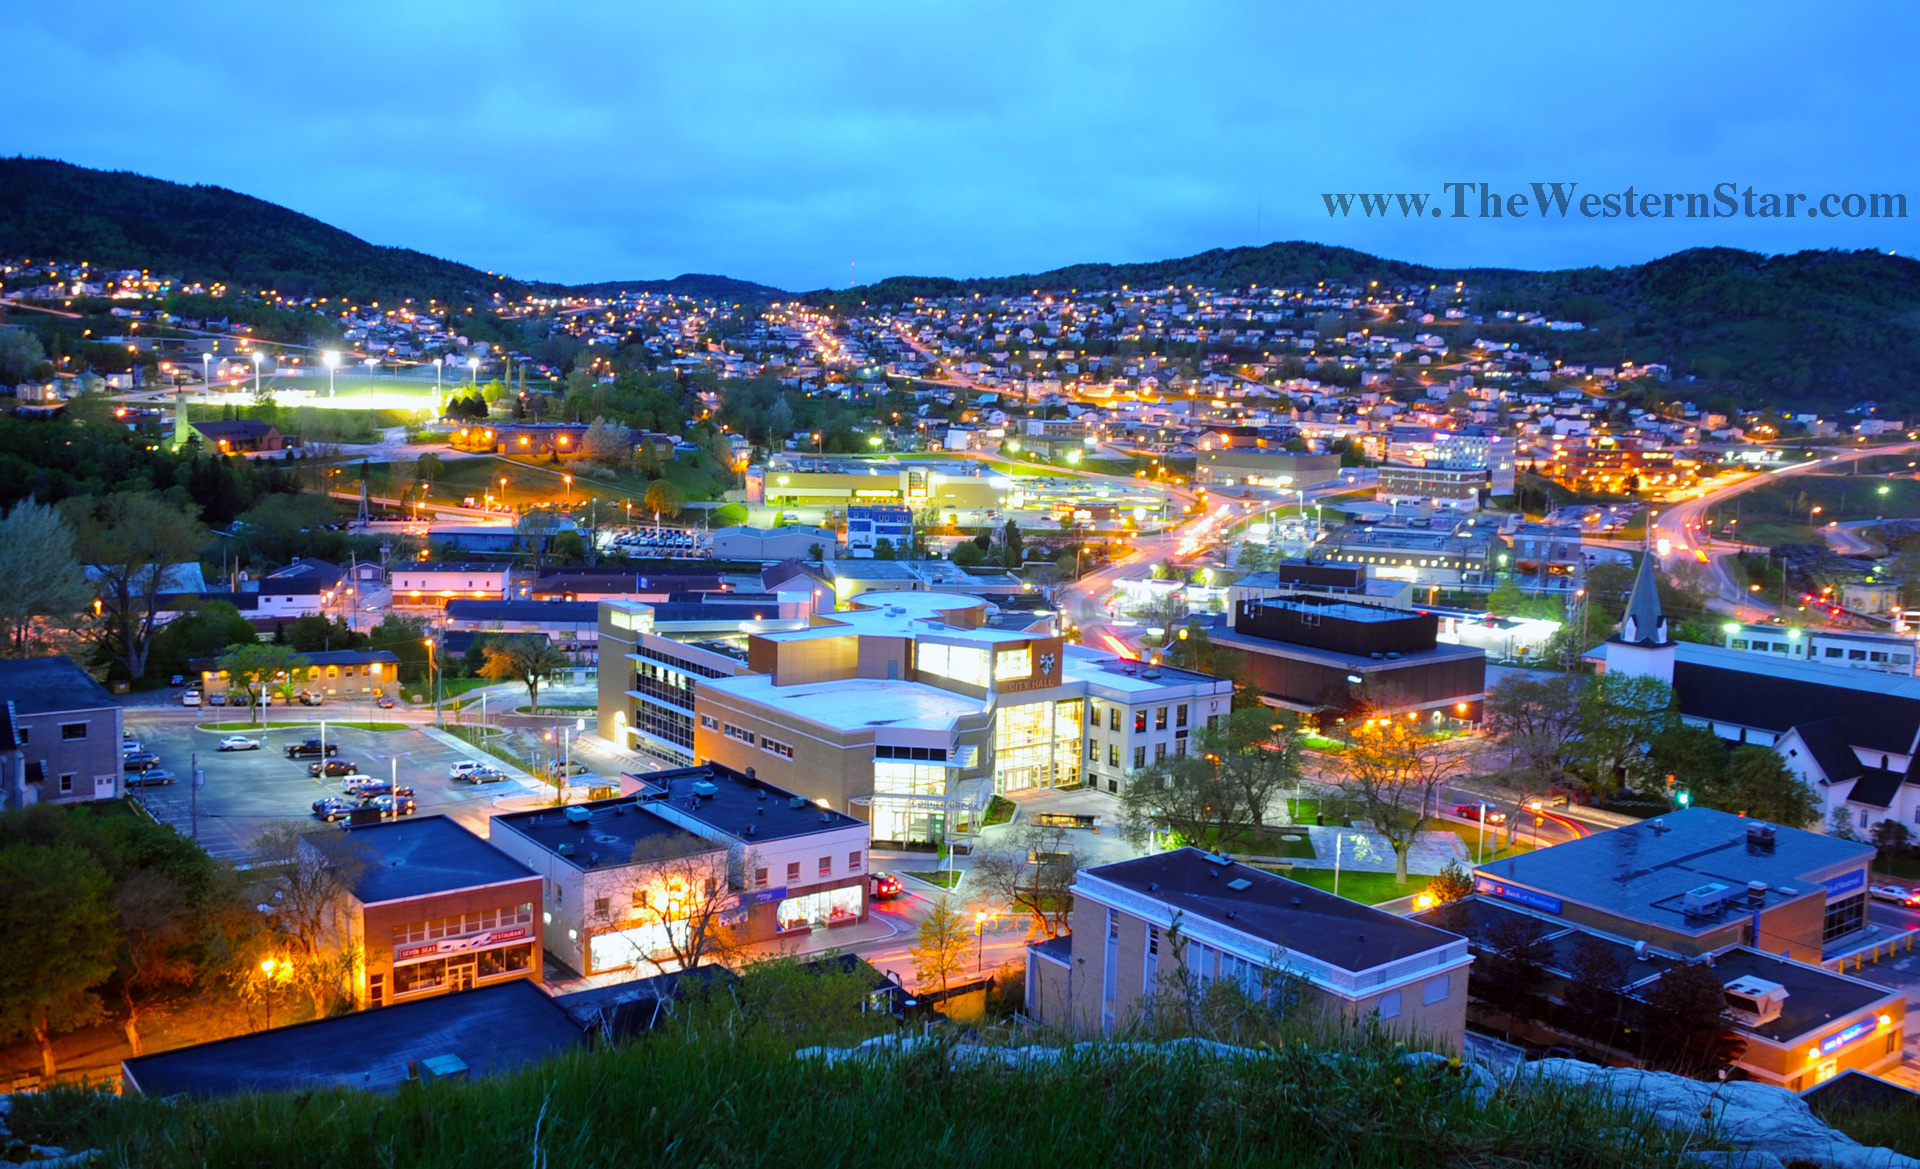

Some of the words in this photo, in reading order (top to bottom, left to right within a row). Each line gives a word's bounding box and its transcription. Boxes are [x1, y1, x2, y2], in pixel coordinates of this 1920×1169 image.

[1008, 681, 1029, 691] CITY
[1032, 678, 1053, 689] HALL
[1505, 889, 1520, 898] Bank
[491, 929, 525, 940] RESTAURANT
[401, 948, 420, 957] SEVEN
[421, 945, 436, 955] SEAS
